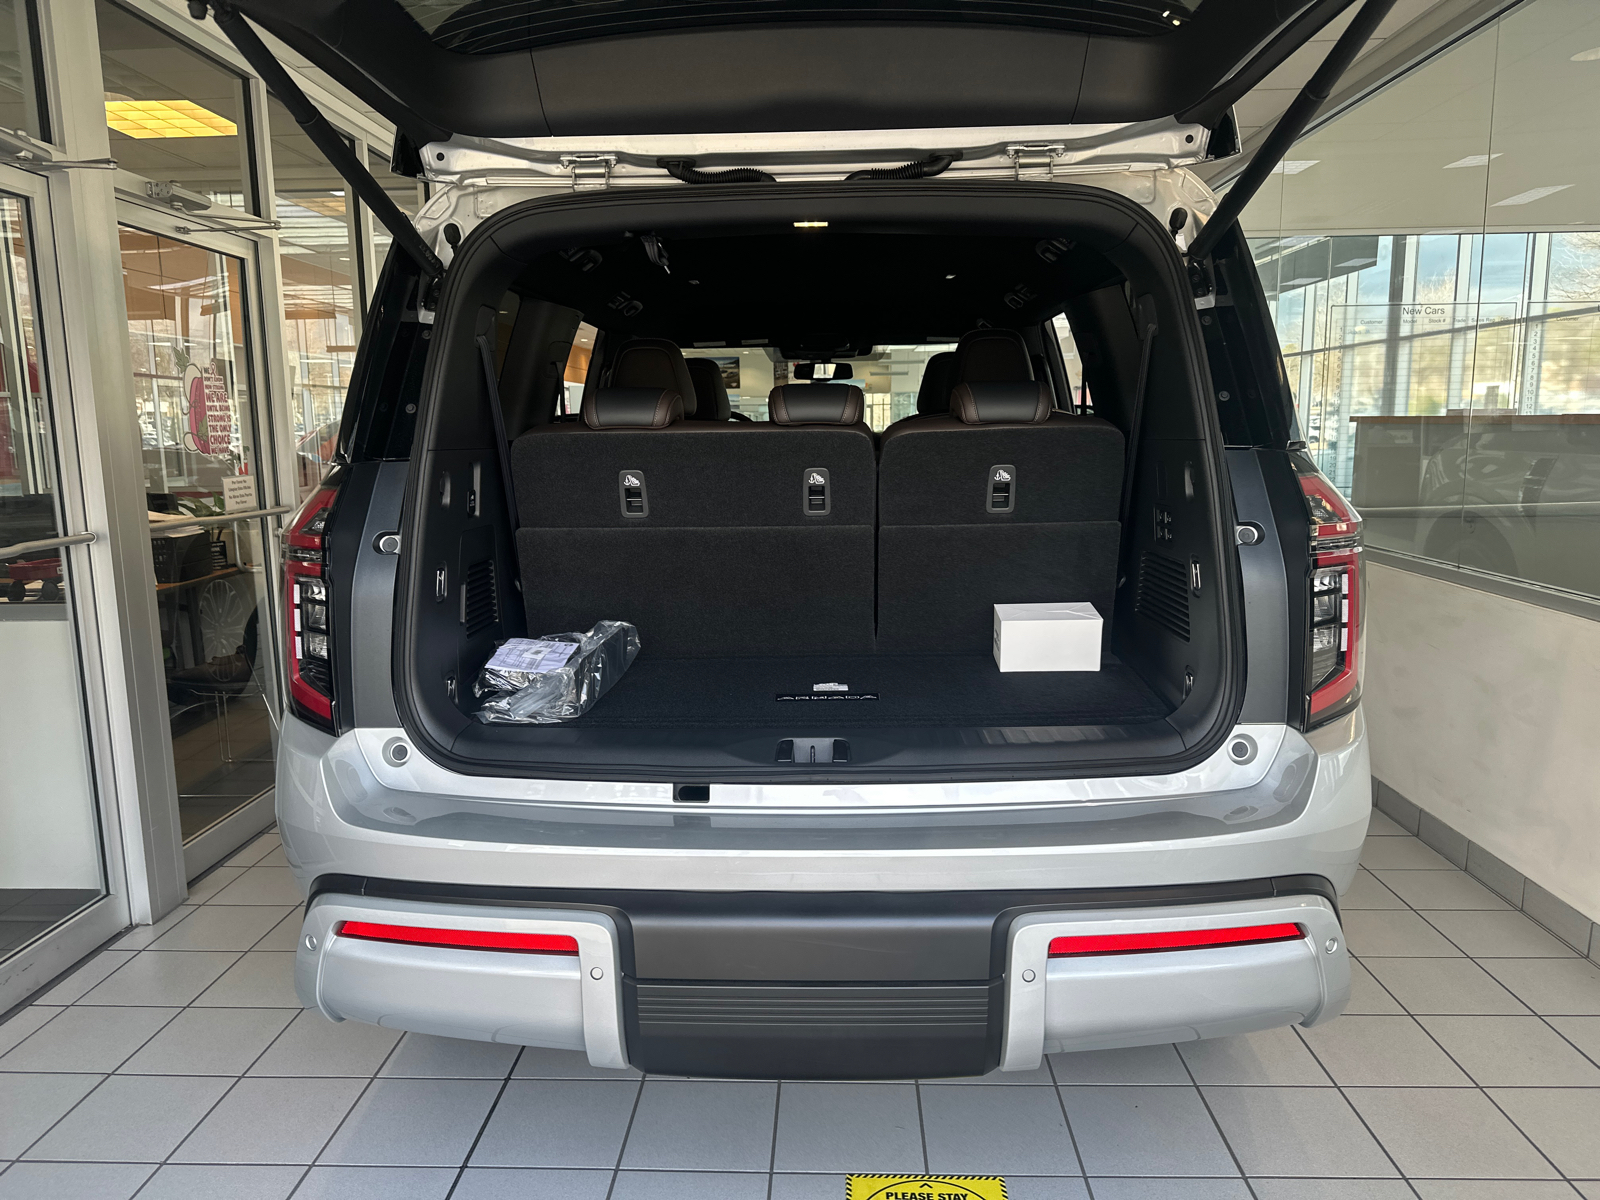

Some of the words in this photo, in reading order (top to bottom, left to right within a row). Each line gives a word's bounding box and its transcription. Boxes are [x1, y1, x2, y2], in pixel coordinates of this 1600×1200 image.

[206, 392, 215, 402] WE
[216, 392, 227, 402] ARE
[208, 414, 226, 422] STRONG
[209, 424, 218, 432] THE
[219, 424, 231, 432] ONLY
[210, 434, 231, 445] CHOICE
[886, 1192, 933, 1200] PLEASE
